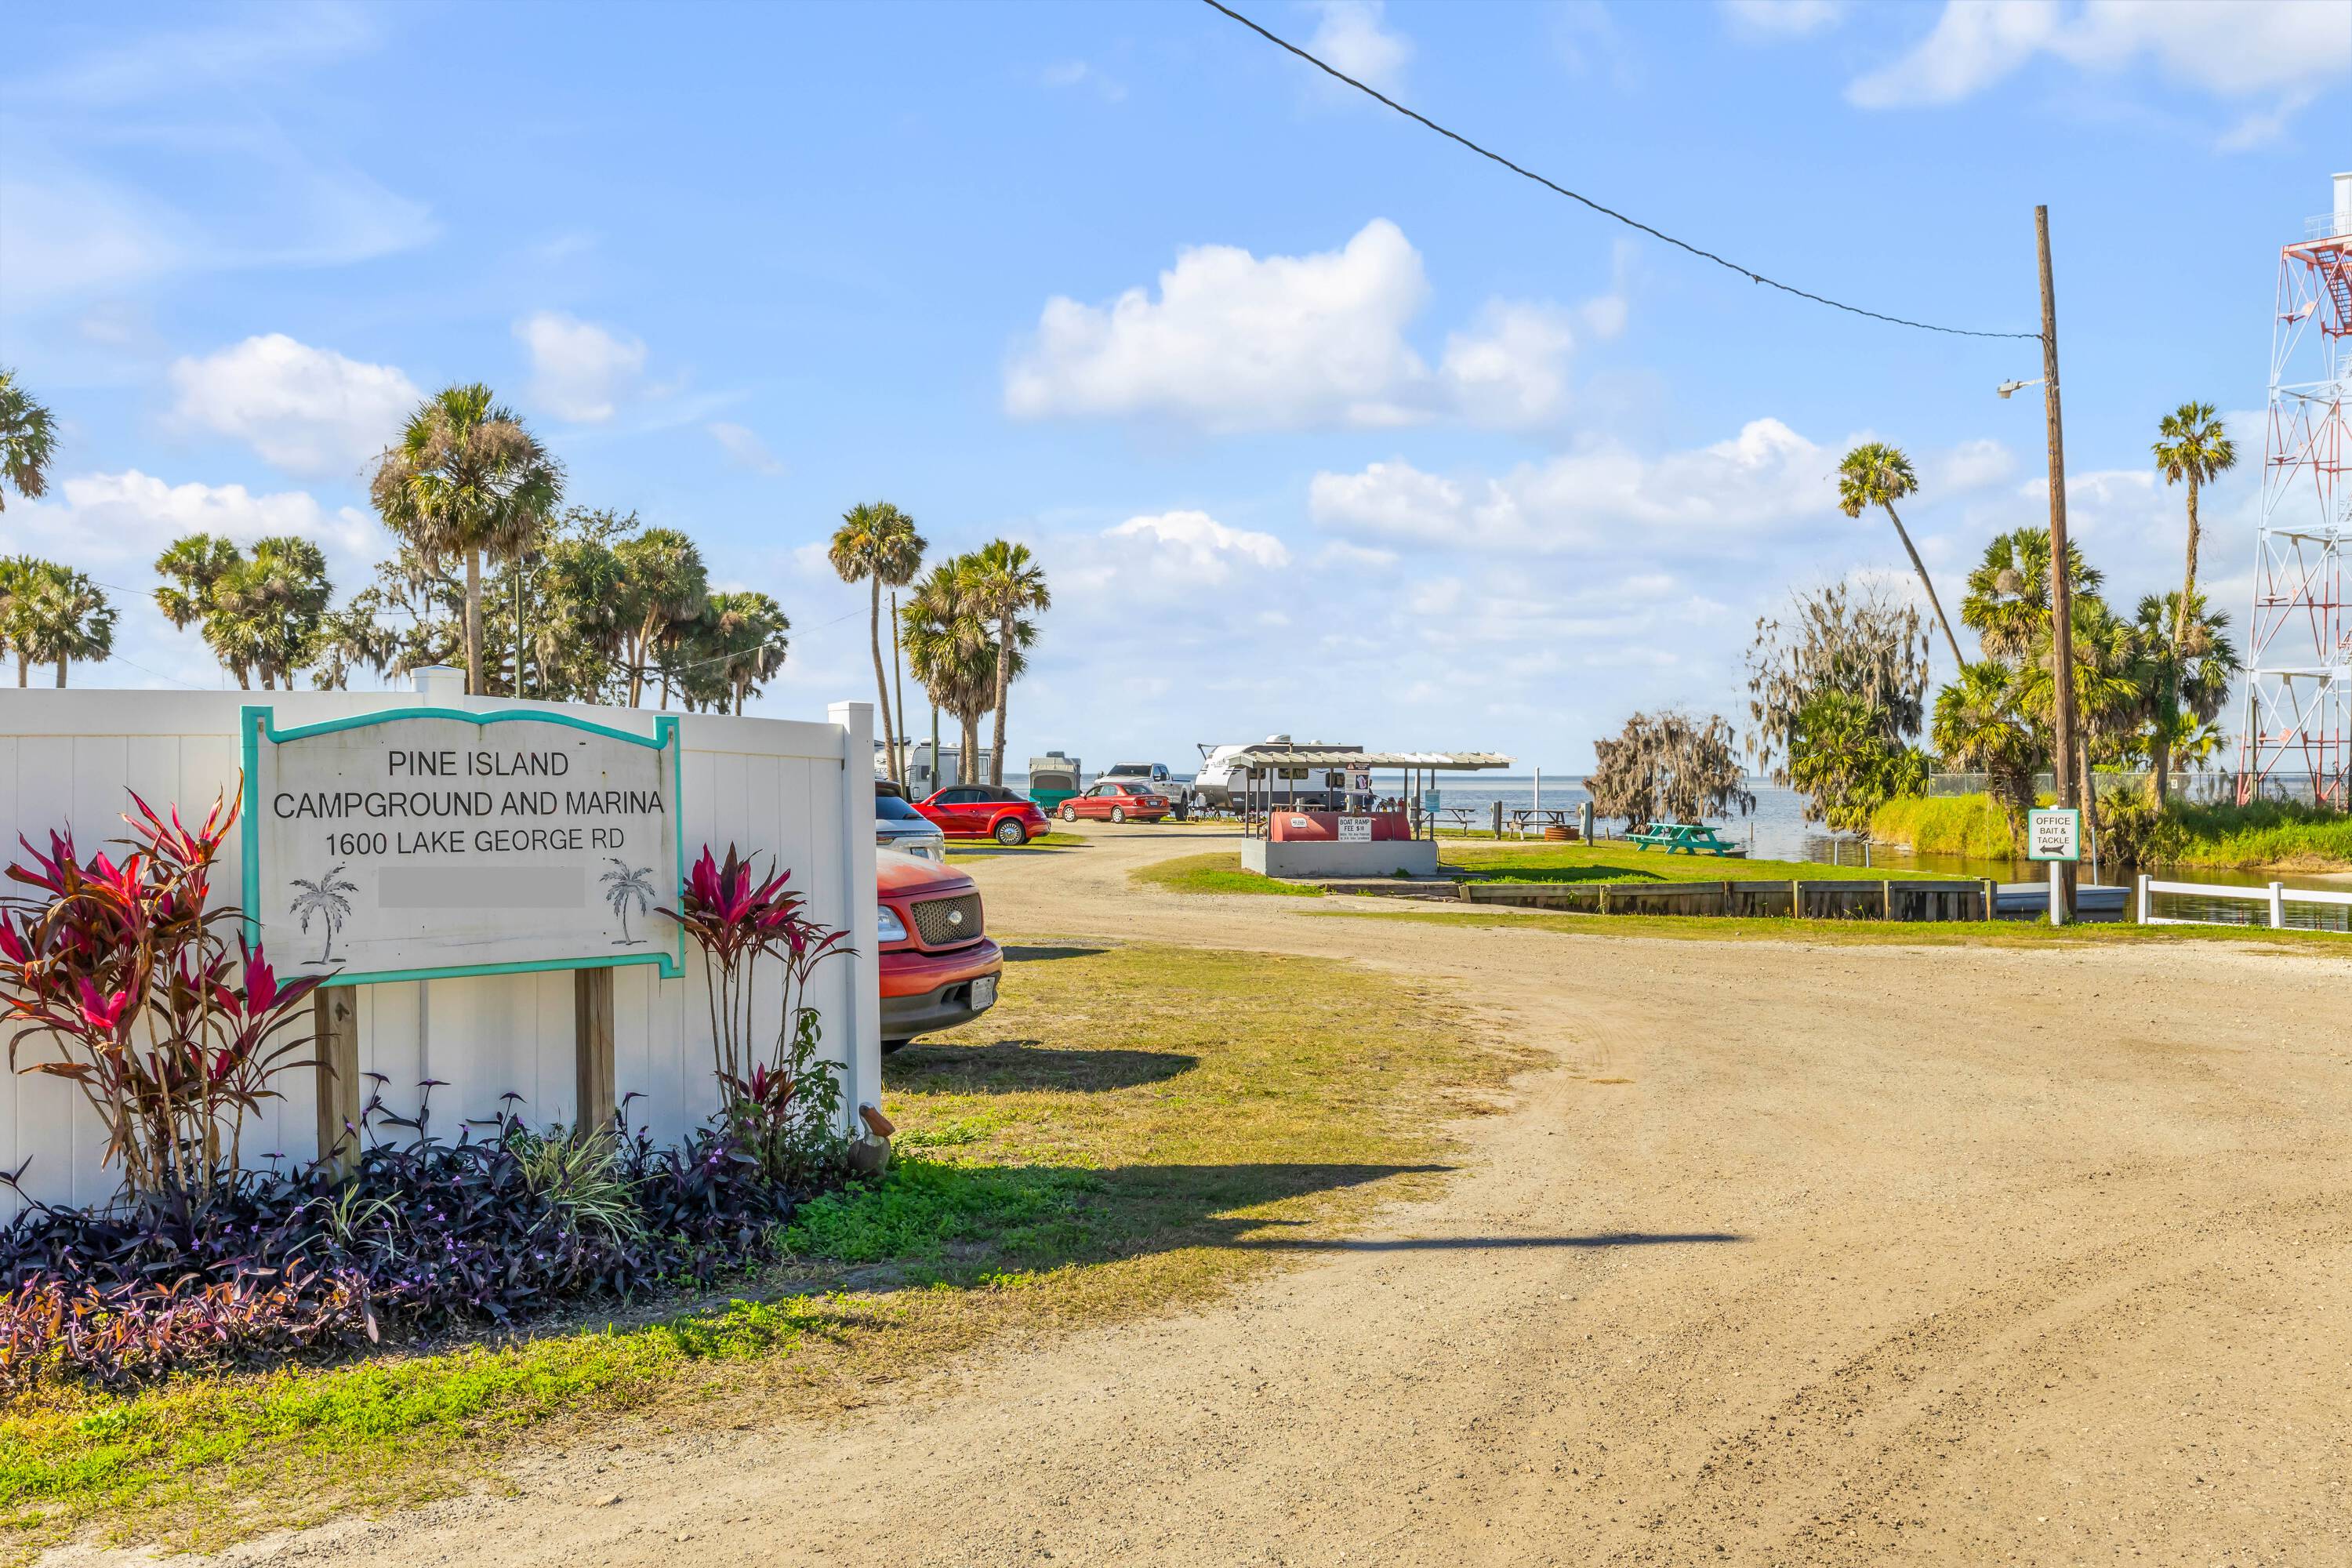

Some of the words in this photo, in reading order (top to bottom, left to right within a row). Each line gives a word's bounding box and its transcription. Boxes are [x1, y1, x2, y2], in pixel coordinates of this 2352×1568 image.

[390, 751, 456, 775] PINE
[469, 752, 568, 775] ISLAND
[274, 792, 492, 818] CAMPGROUND
[501, 792, 557, 815] AND
[567, 791, 664, 815] MARINA
[2036, 817, 2071, 826] OFFICE
[327, 833, 387, 855] 1600
[398, 831, 465, 854] LAKE
[475, 829, 583, 851] GEORGE
[593, 829, 623, 848] RD
